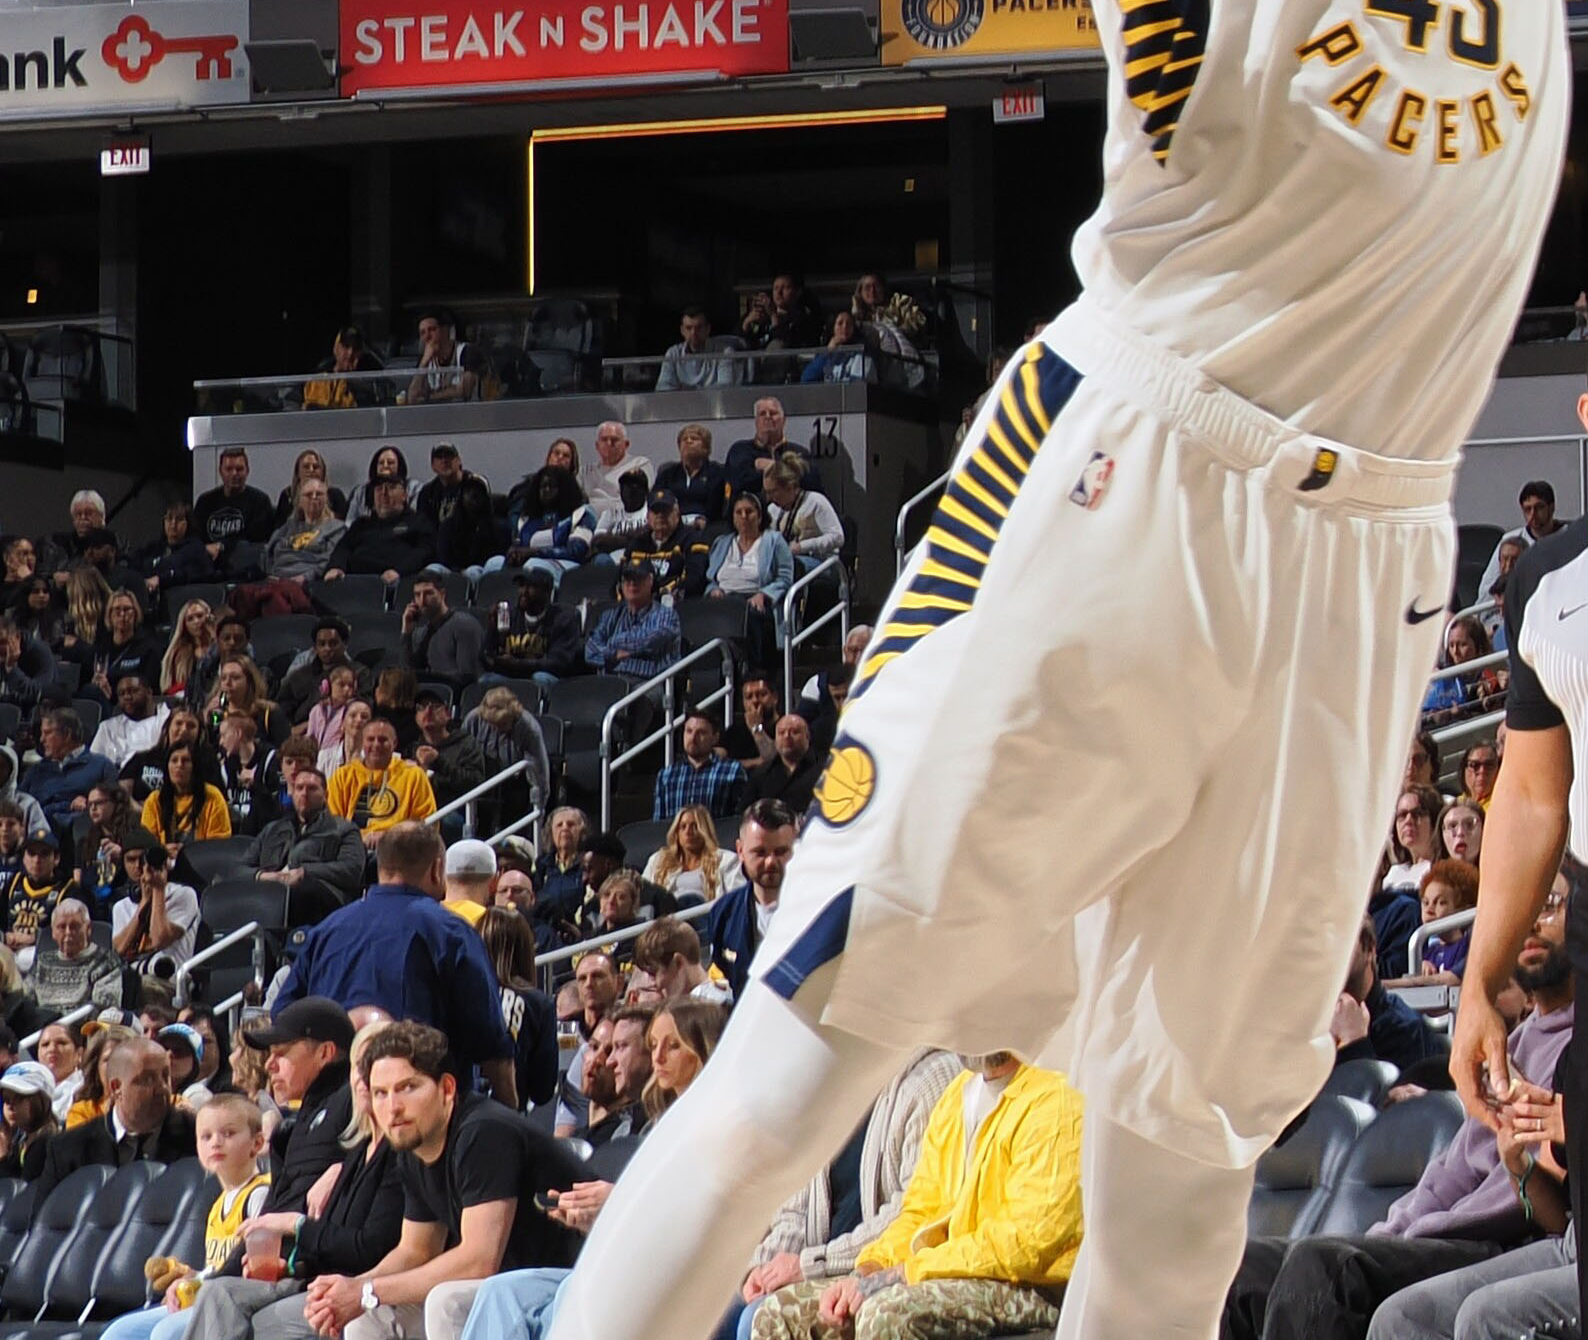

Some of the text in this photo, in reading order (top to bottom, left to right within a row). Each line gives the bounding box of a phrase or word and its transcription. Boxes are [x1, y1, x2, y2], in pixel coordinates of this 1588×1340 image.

[355, 11, 527, 65] STEAK
[539, 16, 564, 50] N
[903, 17, 978, 50] FOUNDATION
[1002, 90, 1038, 117] EXIT
[1294, 21, 1533, 166] PACERS
[109, 148, 142, 166] EXIT
[811, 417, 838, 459] 13
